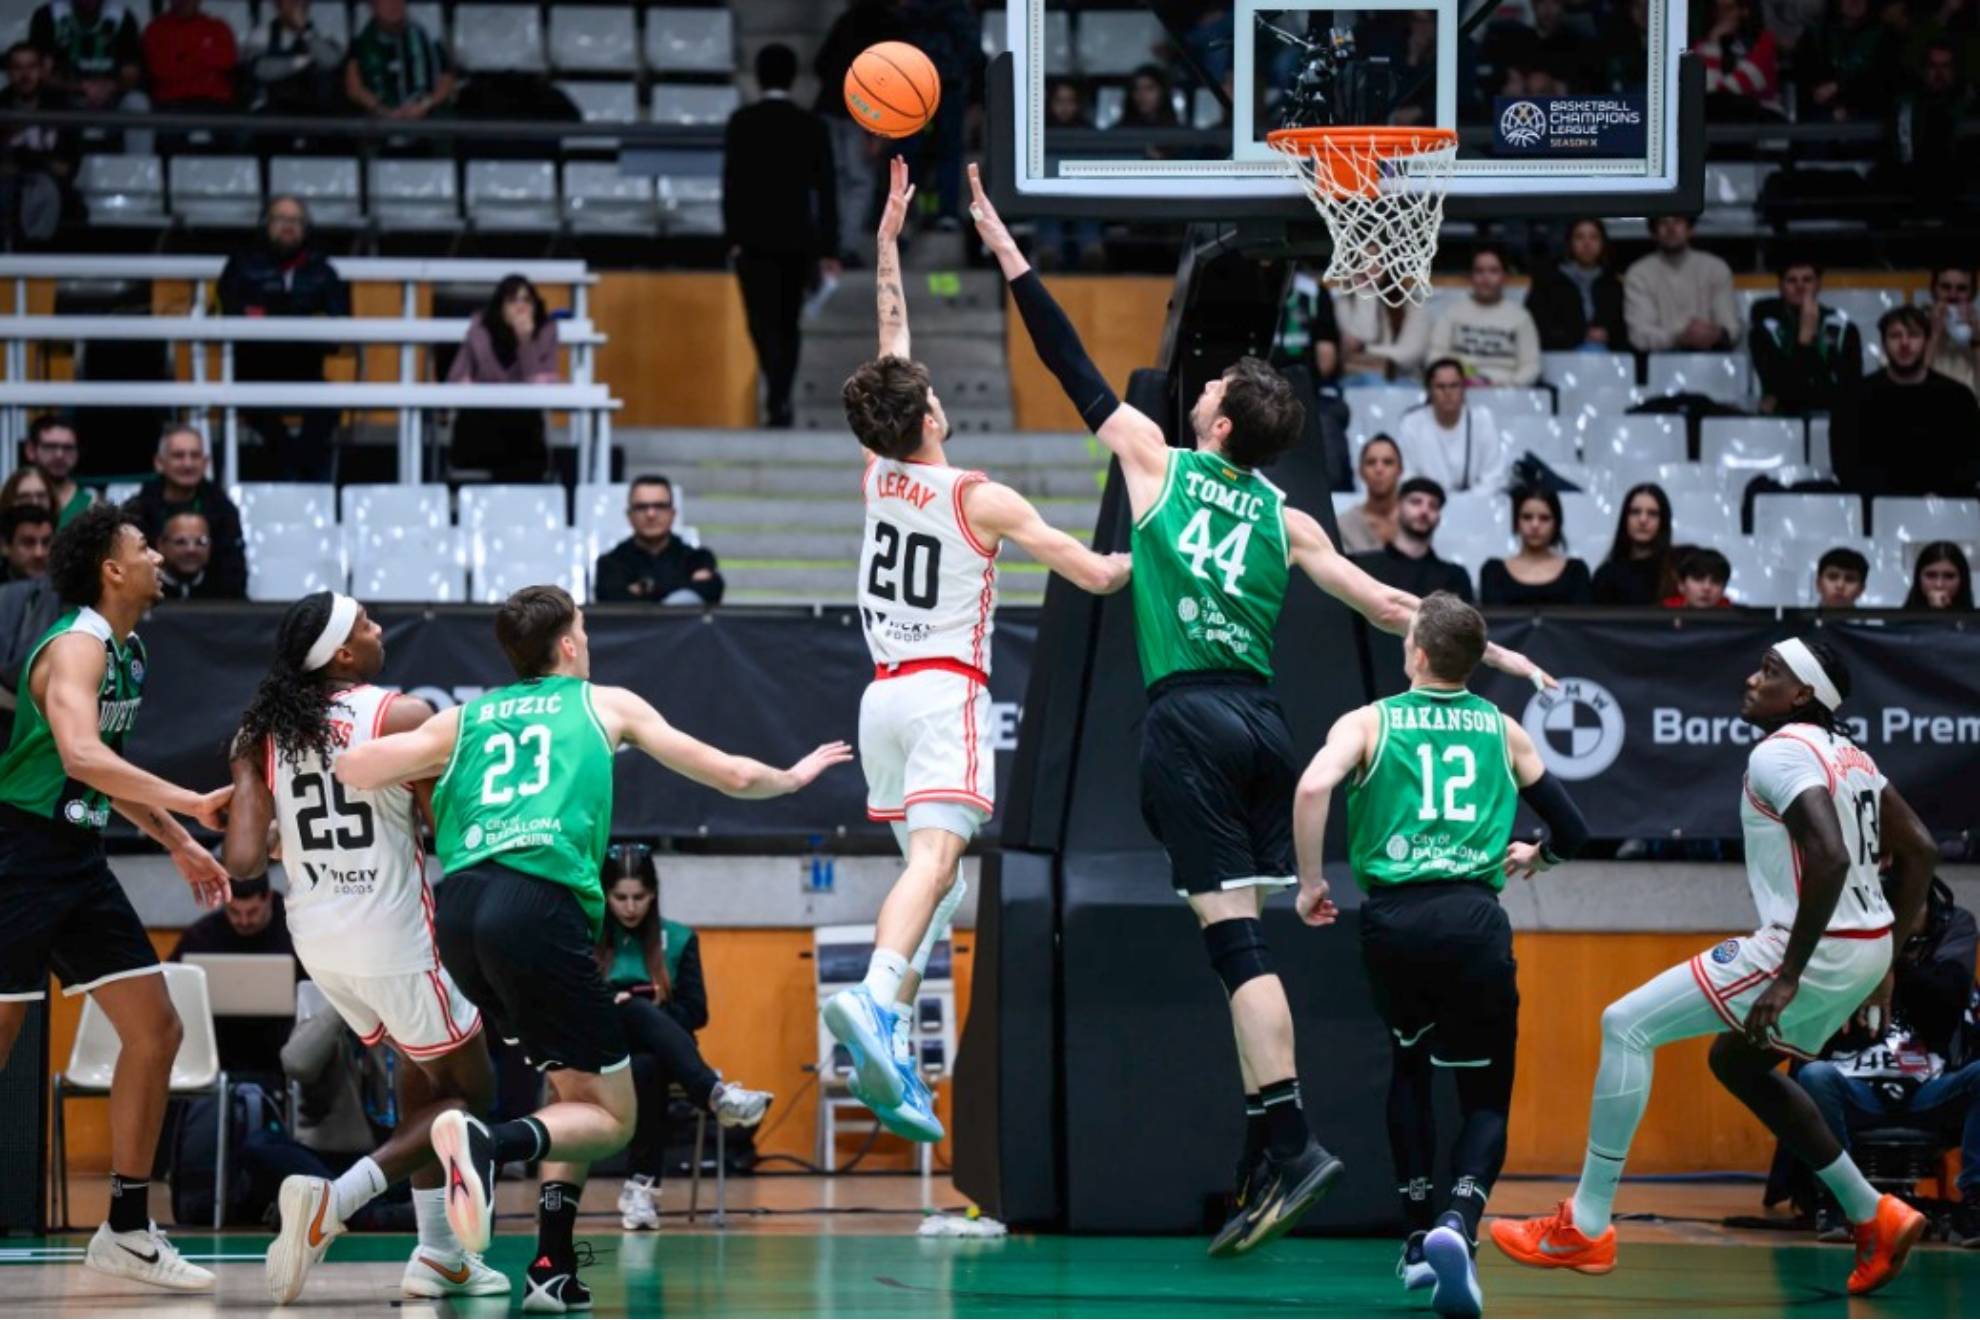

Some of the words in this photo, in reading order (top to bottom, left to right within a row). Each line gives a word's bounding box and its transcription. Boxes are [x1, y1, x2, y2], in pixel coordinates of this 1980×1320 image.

[1550, 101, 1630, 111] BASKETBALL
[1550, 112, 1640, 123] CHAMPIONS
[1550, 125, 1598, 135] LEAGUE
[1550, 138, 1588, 147] SEASON
[1590, 138, 1598, 146] X
[877, 472, 936, 511] LERAY
[1186, 471, 1264, 521] TOMIC
[868, 520, 941, 610] 20
[1178, 507, 1253, 597] 44
[1390, 706, 1499, 735] HAKANSON
[480, 724, 552, 805] 23
[1417, 743, 1476, 822] 12
[291, 771, 374, 851] 25
